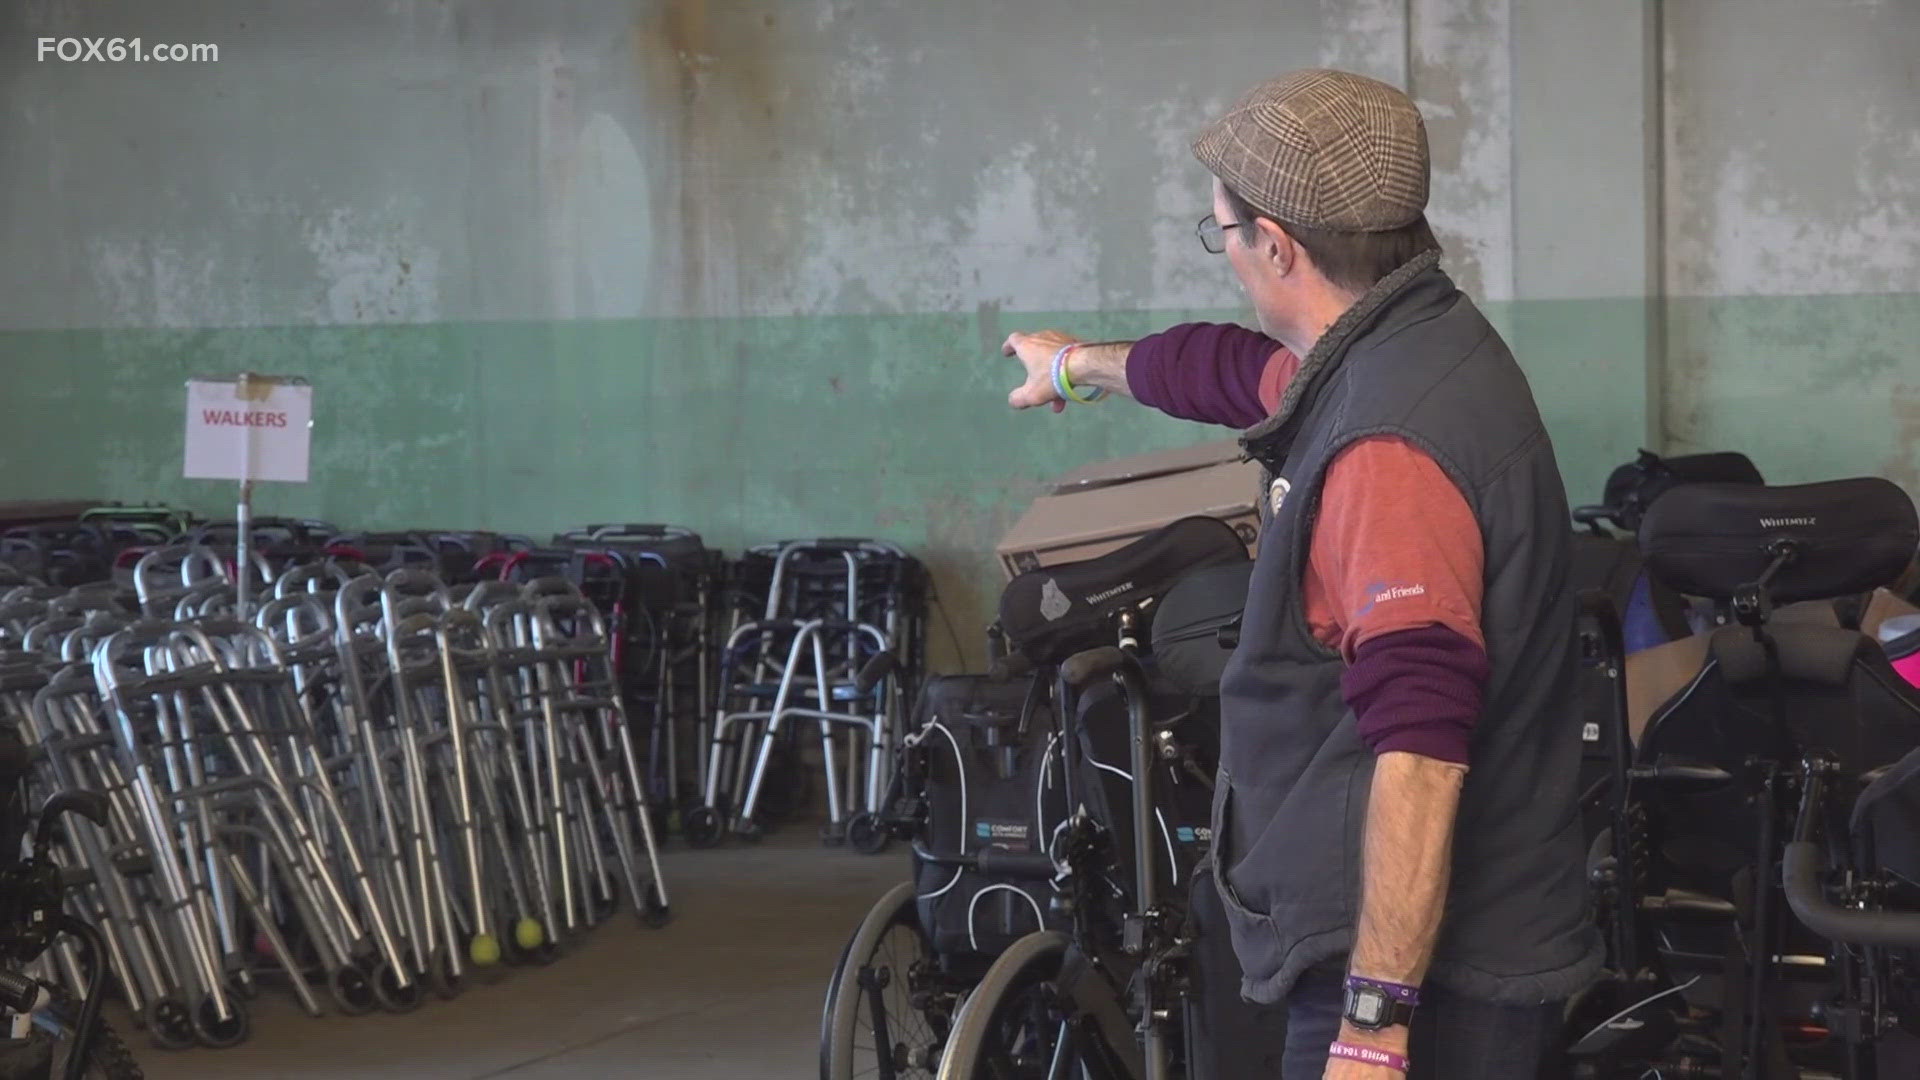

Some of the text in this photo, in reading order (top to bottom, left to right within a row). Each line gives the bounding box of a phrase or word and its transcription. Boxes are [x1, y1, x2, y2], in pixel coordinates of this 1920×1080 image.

[203, 409, 287, 428] WALKERS
[1375, 588, 1391, 603] and
[1391, 583, 1425, 599] Friends
